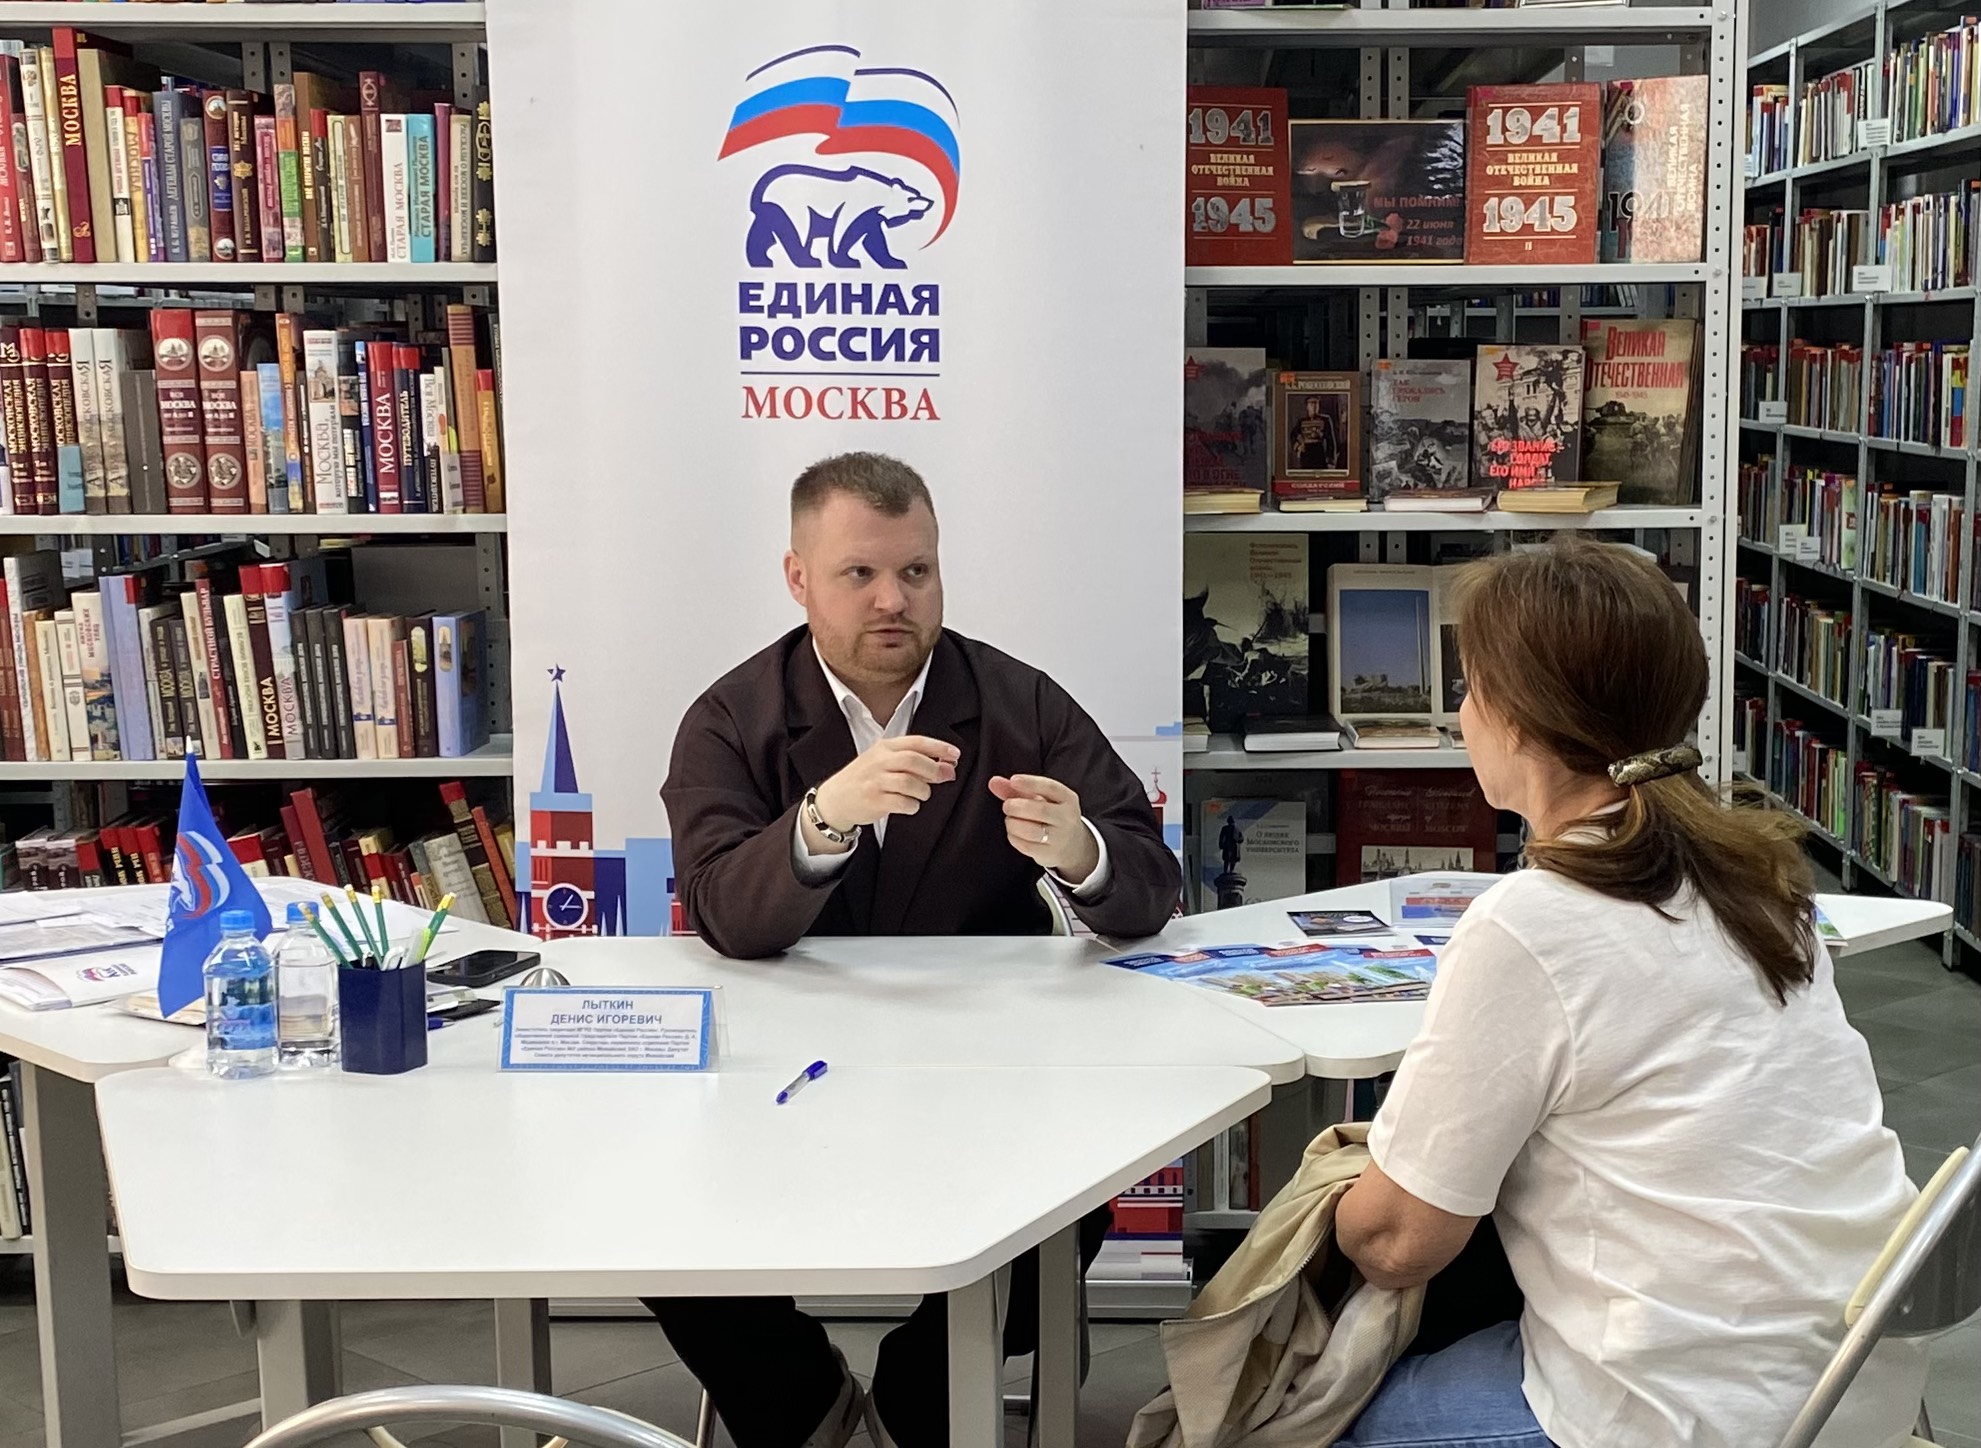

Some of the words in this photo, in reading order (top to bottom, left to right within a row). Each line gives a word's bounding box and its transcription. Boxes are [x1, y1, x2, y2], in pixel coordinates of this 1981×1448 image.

[60, 74, 81, 146] МОСКВА
[160, 100, 173, 133] МОСКВЫ
[1188, 107, 1274, 146] 1941
[1485, 106, 1582, 145] 1941
[162, 133, 175, 164] СТАРОЙ
[418, 135, 430, 186] МОСКВА
[1209, 153, 1256, 164] ВЕЛИКАЯ
[1507, 153, 1558, 164] ВЕЛИКАЯ
[1666, 126, 1679, 188] ВЕЛИКАЯ
[1676, 103, 1690, 212] ОТЕЧЕСТВЕННАЯ
[164, 164, 178, 200] ЛЕГЕНДЫ
[394, 162, 404, 210] МОСКВА
[1191, 164, 1274, 176] ОТЕЧЕСТВЕННАЯ
[1216, 175, 1250, 187] ВОЙНА
[1486, 163, 1579, 176] ОТЕЧЕСТВЕННАЯ
[1512, 174, 1550, 187] ВОЙНА
[1687, 163, 1698, 211] ВОЙНА
[419, 190, 431, 238] СТАРАЯ
[1191, 196, 1277, 233] 1945
[1373, 196, 1396, 208] МЫ
[1482, 195, 1578, 234] 1945
[395, 216, 407, 259] СТАРАЯ
[1406, 219, 1420, 230] 22
[1422, 220, 1454, 230] июня
[1406, 235, 1433, 246] 1941
[738, 281, 940, 319] ЕДИНАЯ
[739, 326, 940, 362] РОССИЯ
[3, 379, 18, 454] МОСКОВСКАЯ
[12, 379, 27, 454] ЭНЦИКЛОПЕДИЯ
[26, 378, 41, 452] МОСКОВСКАЯ
[51, 379, 66, 447] ОСКОВСКАЯ
[61, 379, 75, 444] ЦИКЛОПЕДИЯ
[159, 400, 196, 409] МОСКВА
[202, 401, 237, 410] МОСКВА
[741, 385, 941, 421] МОСКВА
[329, 404, 338, 445] потеряли
[375, 393, 395, 473] МОСКВА
[399, 390, 412, 467] ПУТЕВОДИТЕЛЬ
[332, 446, 339, 460] мы
[1489, 465, 1509, 477] ЕГО
[333, 461, 343, 498] которую
[200, 587, 215, 626] БУЛЬВАР
[204, 627, 221, 680] СТРАСТНОЙ
[259, 676, 281, 737] МОСКВА
[280, 676, 298, 736] МОСКВА
[550, 1014, 593, 1025] ДЕНИС
[596, 1014, 662, 1025] ИГОРЕВИЧ
[581, 1000, 634, 1010] ЛЫТКИН
